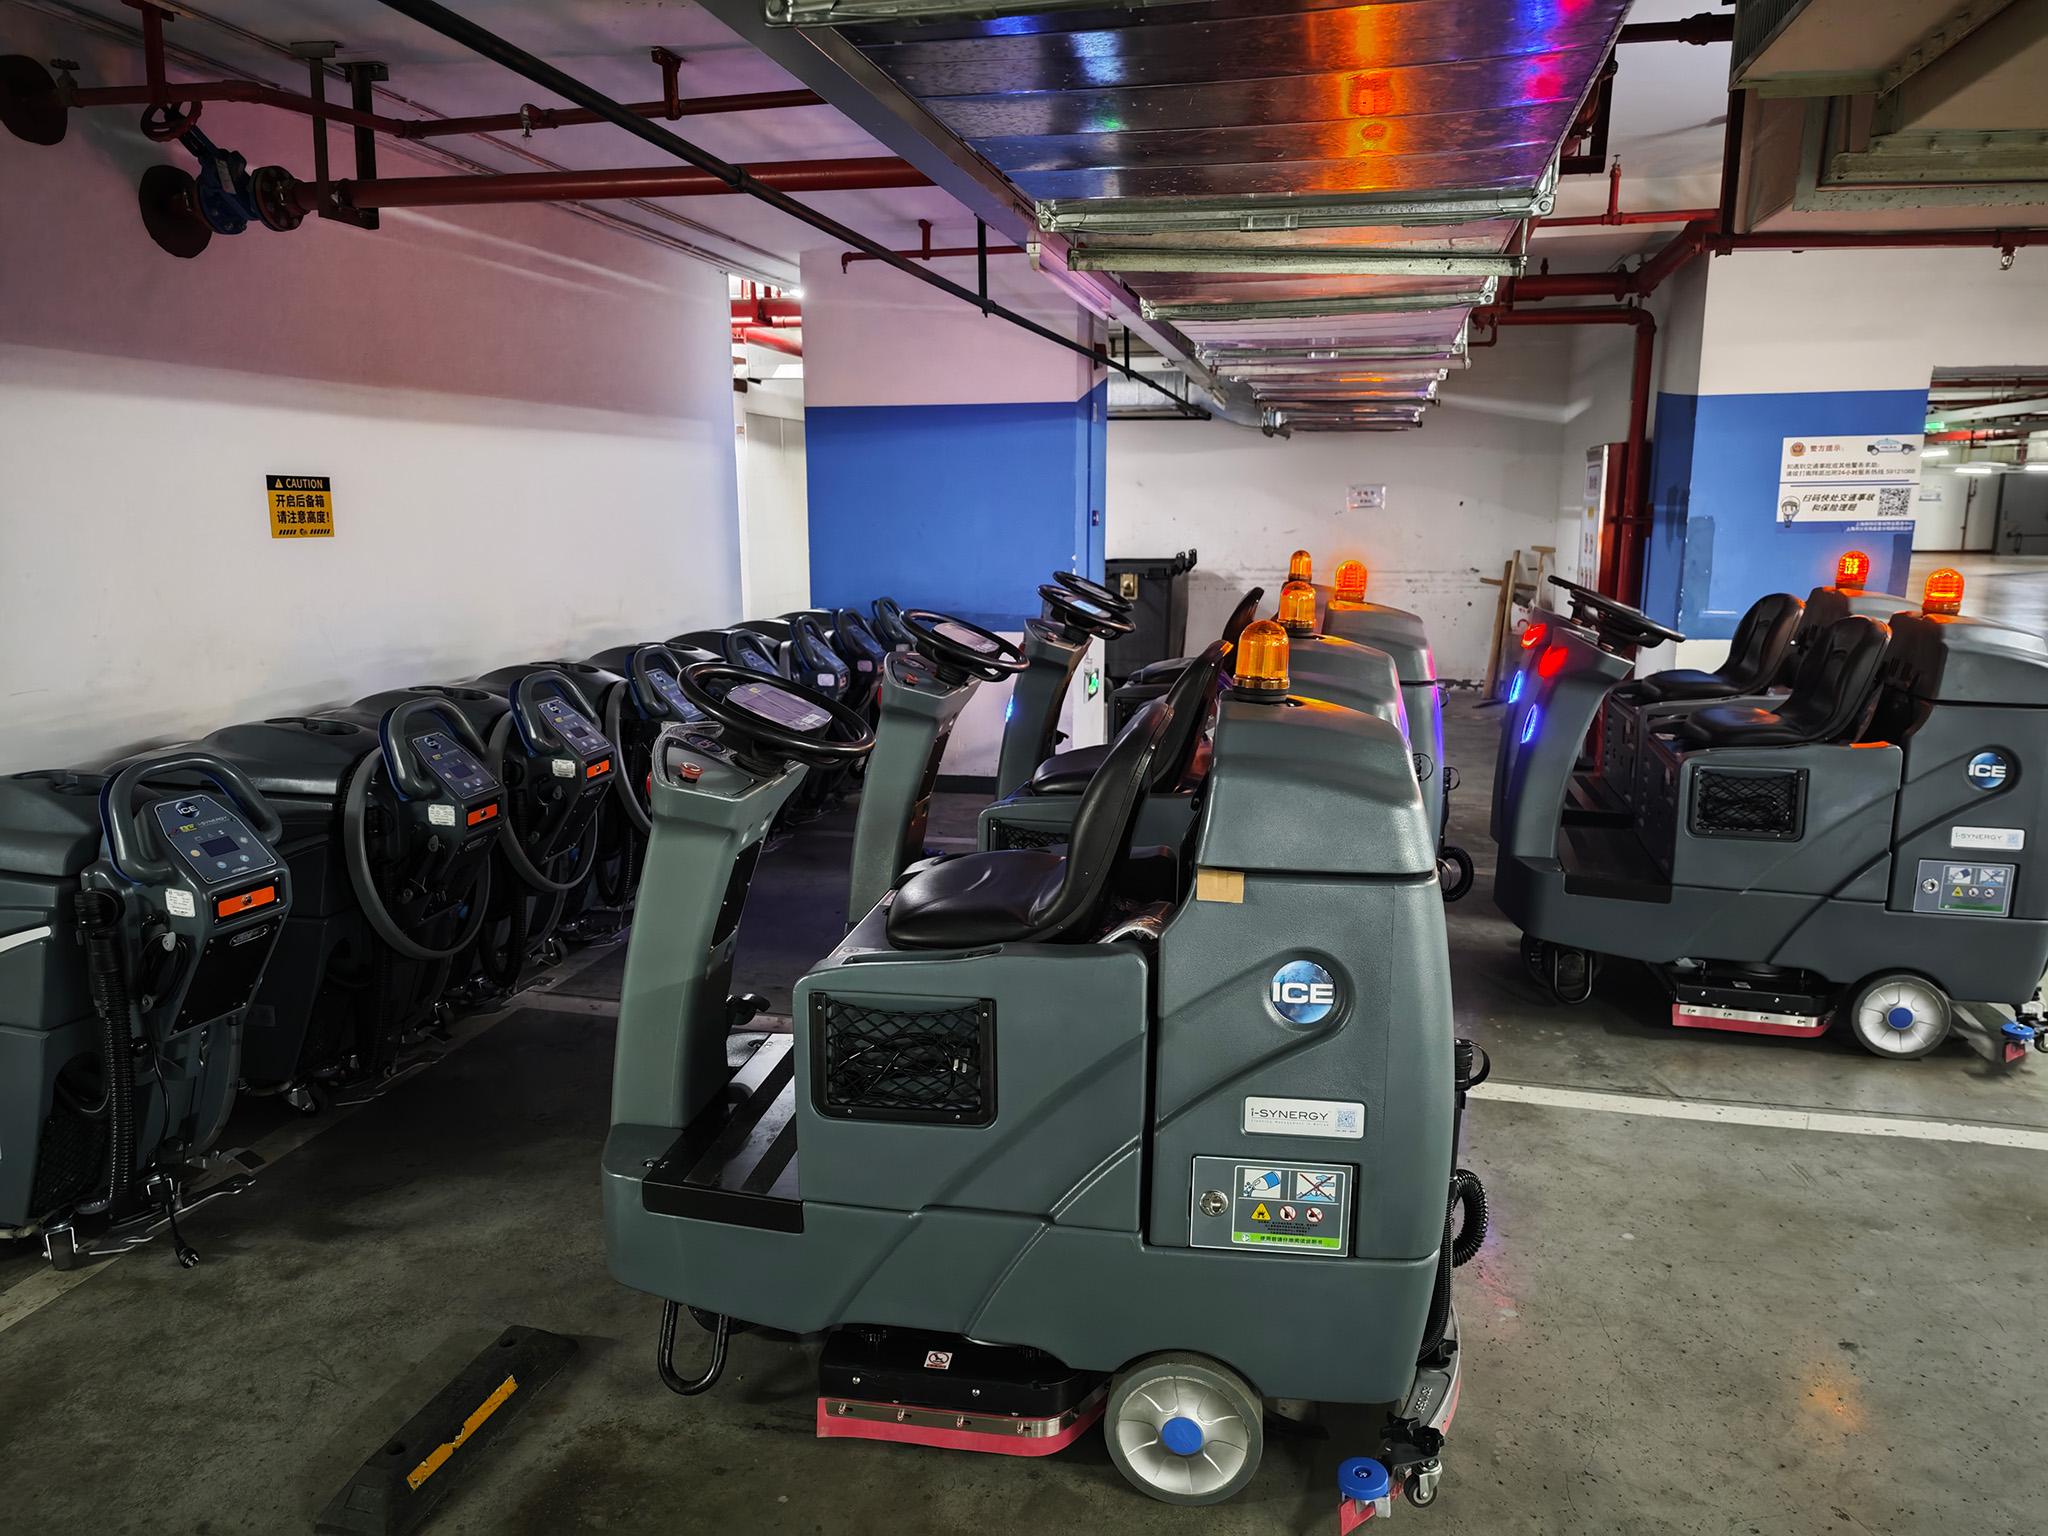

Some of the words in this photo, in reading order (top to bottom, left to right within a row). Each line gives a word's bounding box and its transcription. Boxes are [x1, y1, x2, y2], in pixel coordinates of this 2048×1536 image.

[286, 478, 323, 489] CAUTION
[275, 494, 325, 508] 开启后备箱
[1968, 764, 2007, 778] ICE
[177, 805, 198, 815] ICE
[1272, 982, 1334, 1004] ICE
[1250, 1108, 1329, 1121] i-SYNERGY
